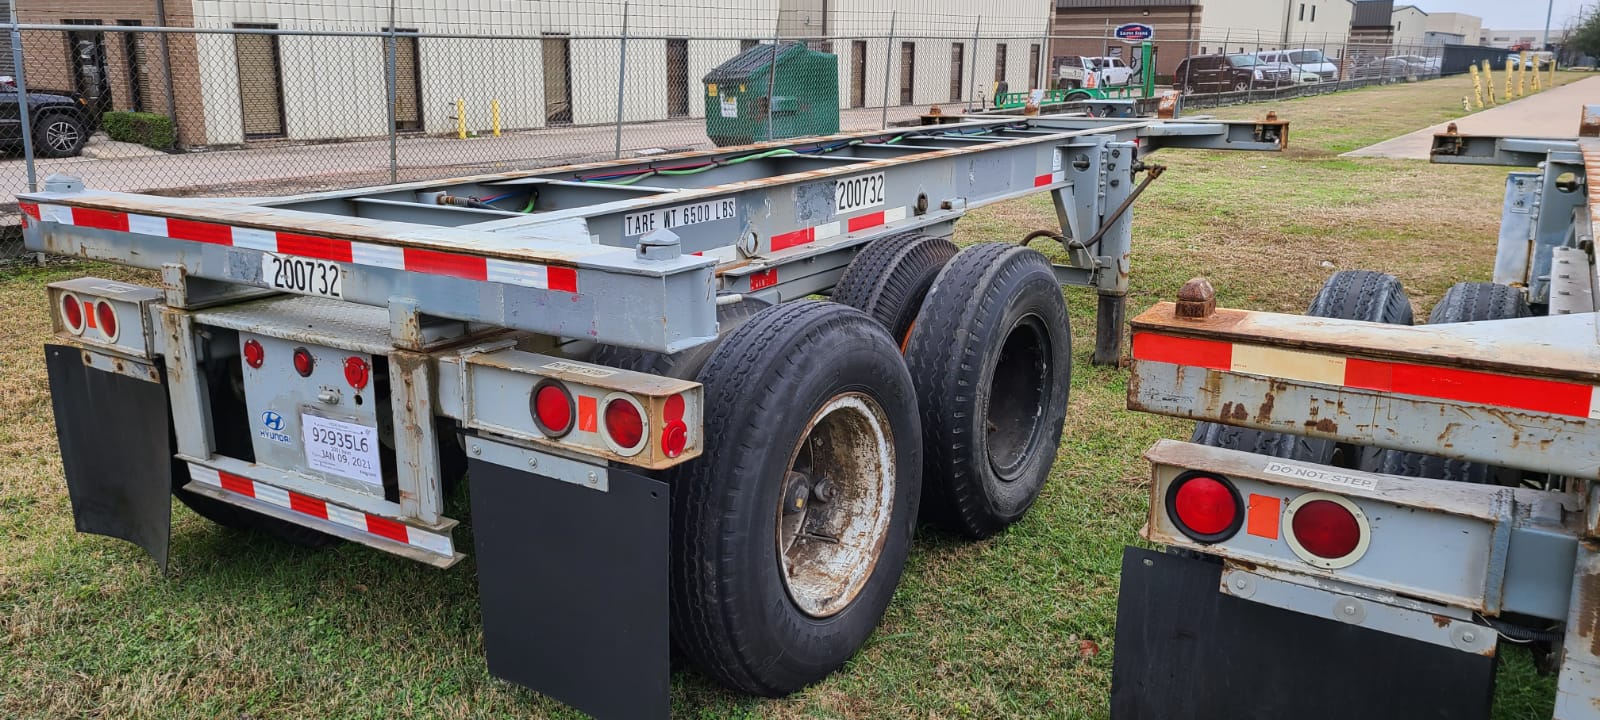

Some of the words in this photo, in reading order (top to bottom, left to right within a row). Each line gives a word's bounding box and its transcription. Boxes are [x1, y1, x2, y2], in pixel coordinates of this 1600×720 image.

[838, 174, 884, 211] 200732
[625, 212, 655, 235] TARE
[663, 209, 677, 229] WT
[683, 204, 710, 225] 6500
[715, 201, 734, 220] LBS
[273, 258, 339, 297] 200732
[312, 427, 369, 453] 92935L6
[320, 449, 336, 461] JAN
[352, 456, 371, 470] 2021
[1270, 464, 1292, 474] DO
[1296, 468, 1327, 479] NOT
[1331, 475, 1372, 487] STEP
